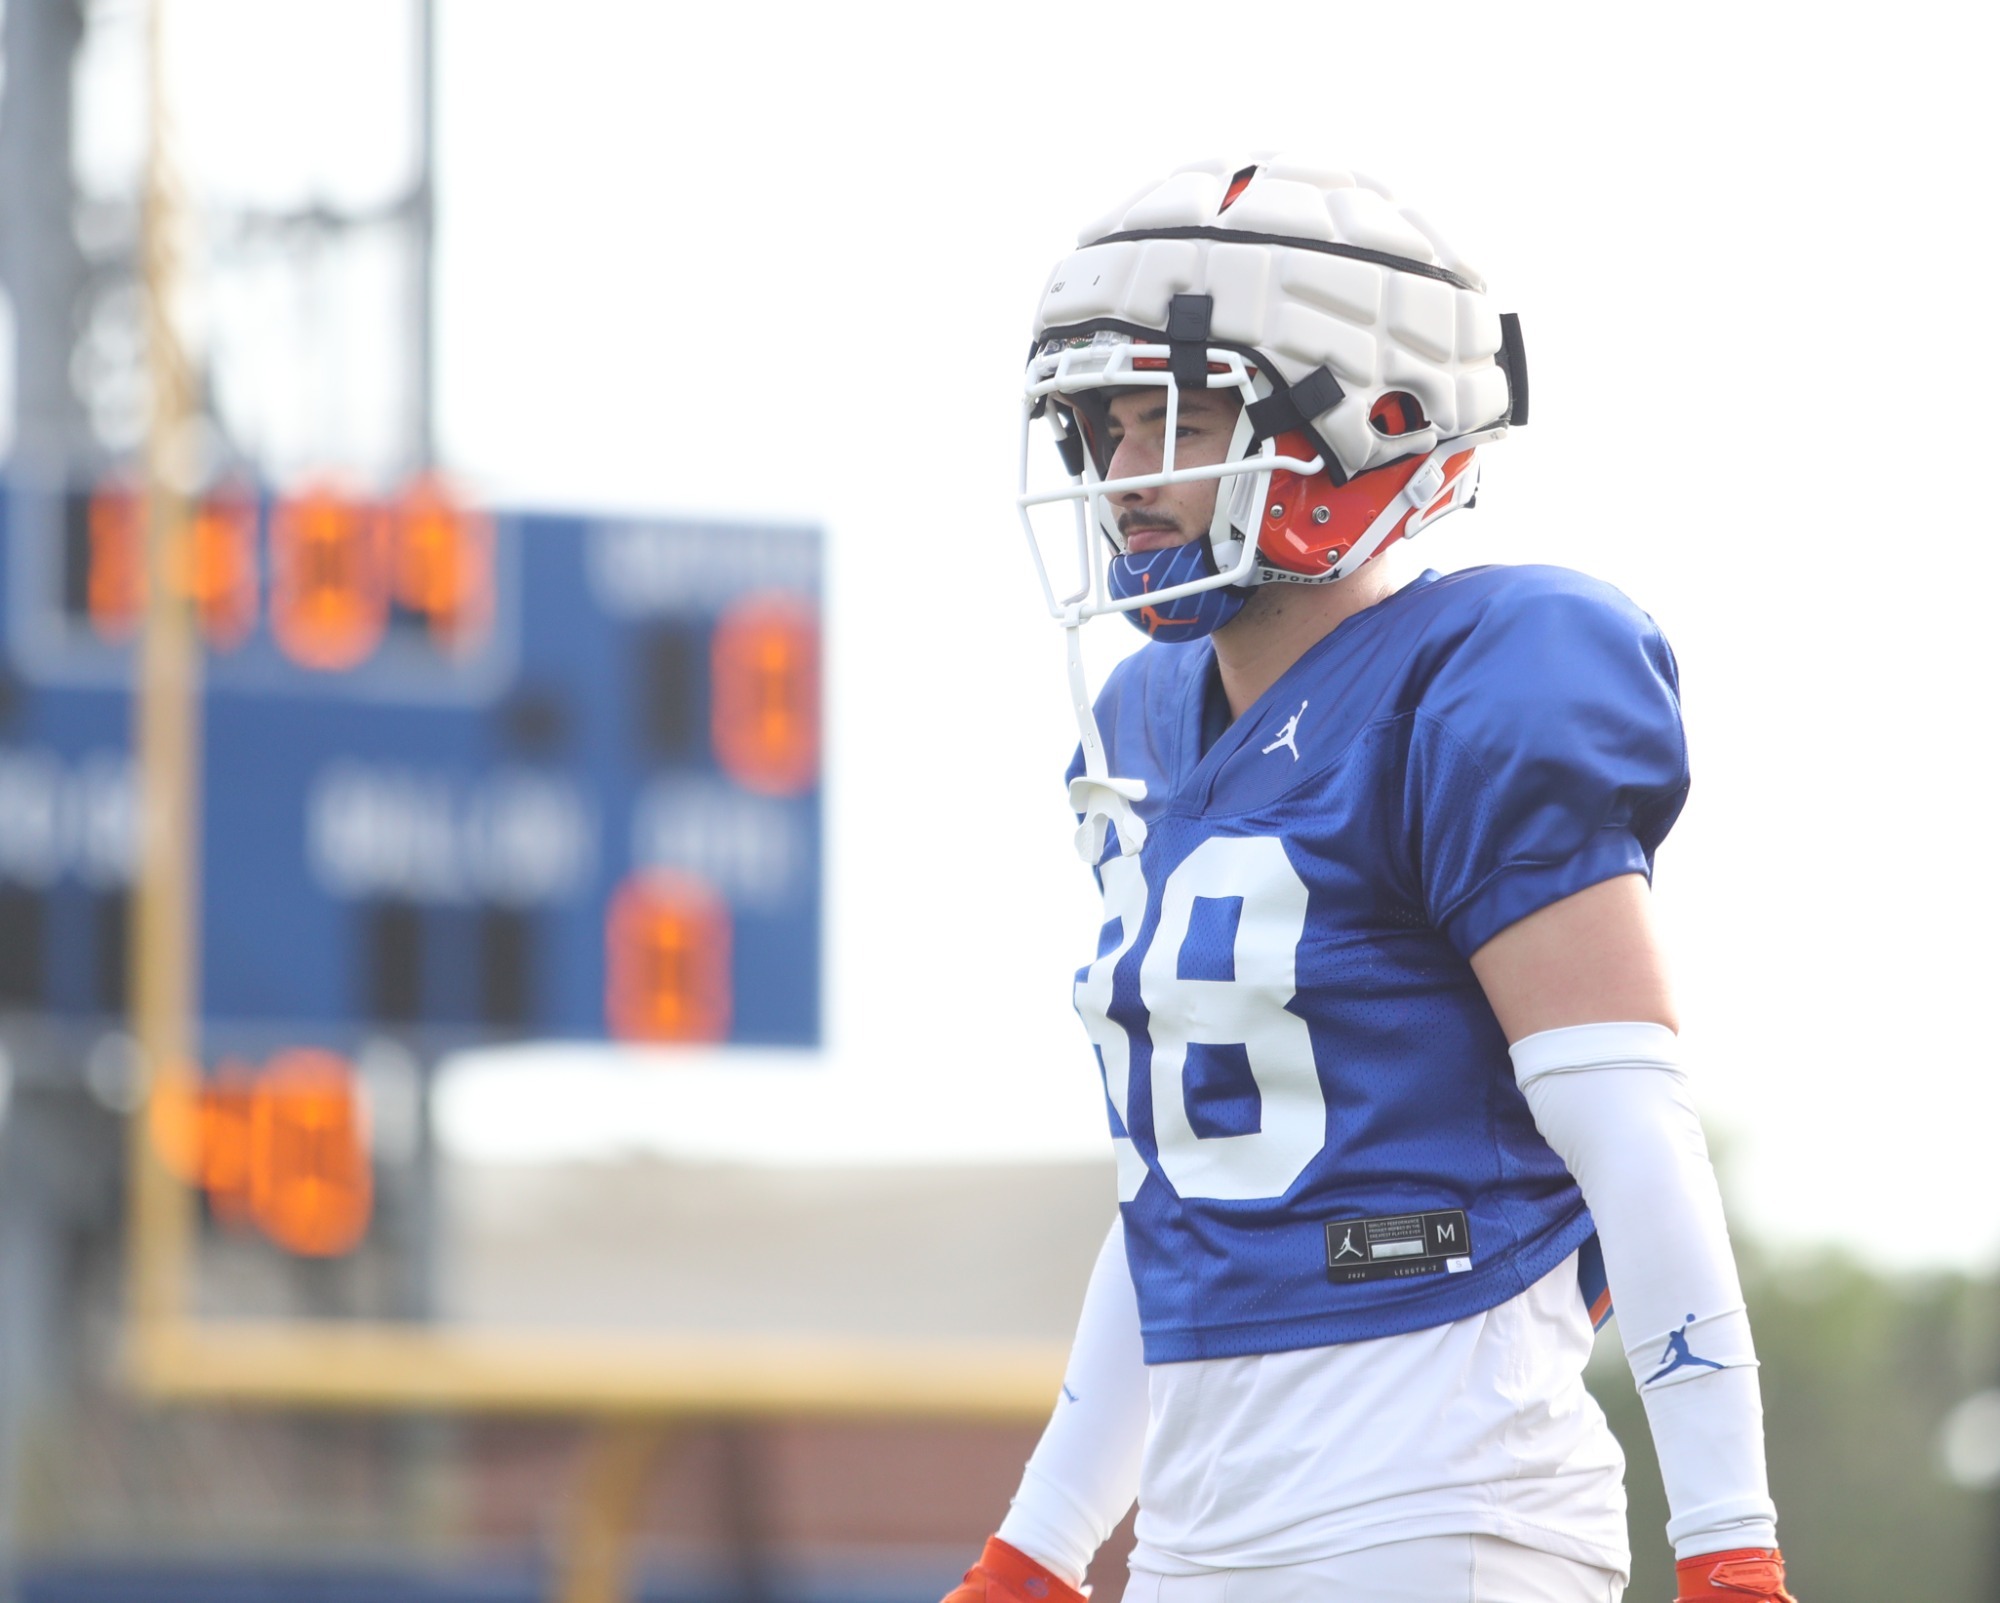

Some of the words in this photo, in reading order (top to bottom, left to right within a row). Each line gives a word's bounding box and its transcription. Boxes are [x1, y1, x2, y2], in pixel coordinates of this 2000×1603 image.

[1436, 1223, 1455, 1243] M
[1455, 1260, 1463, 1269] S
[1394, 1266, 1426, 1276] LENGTH
